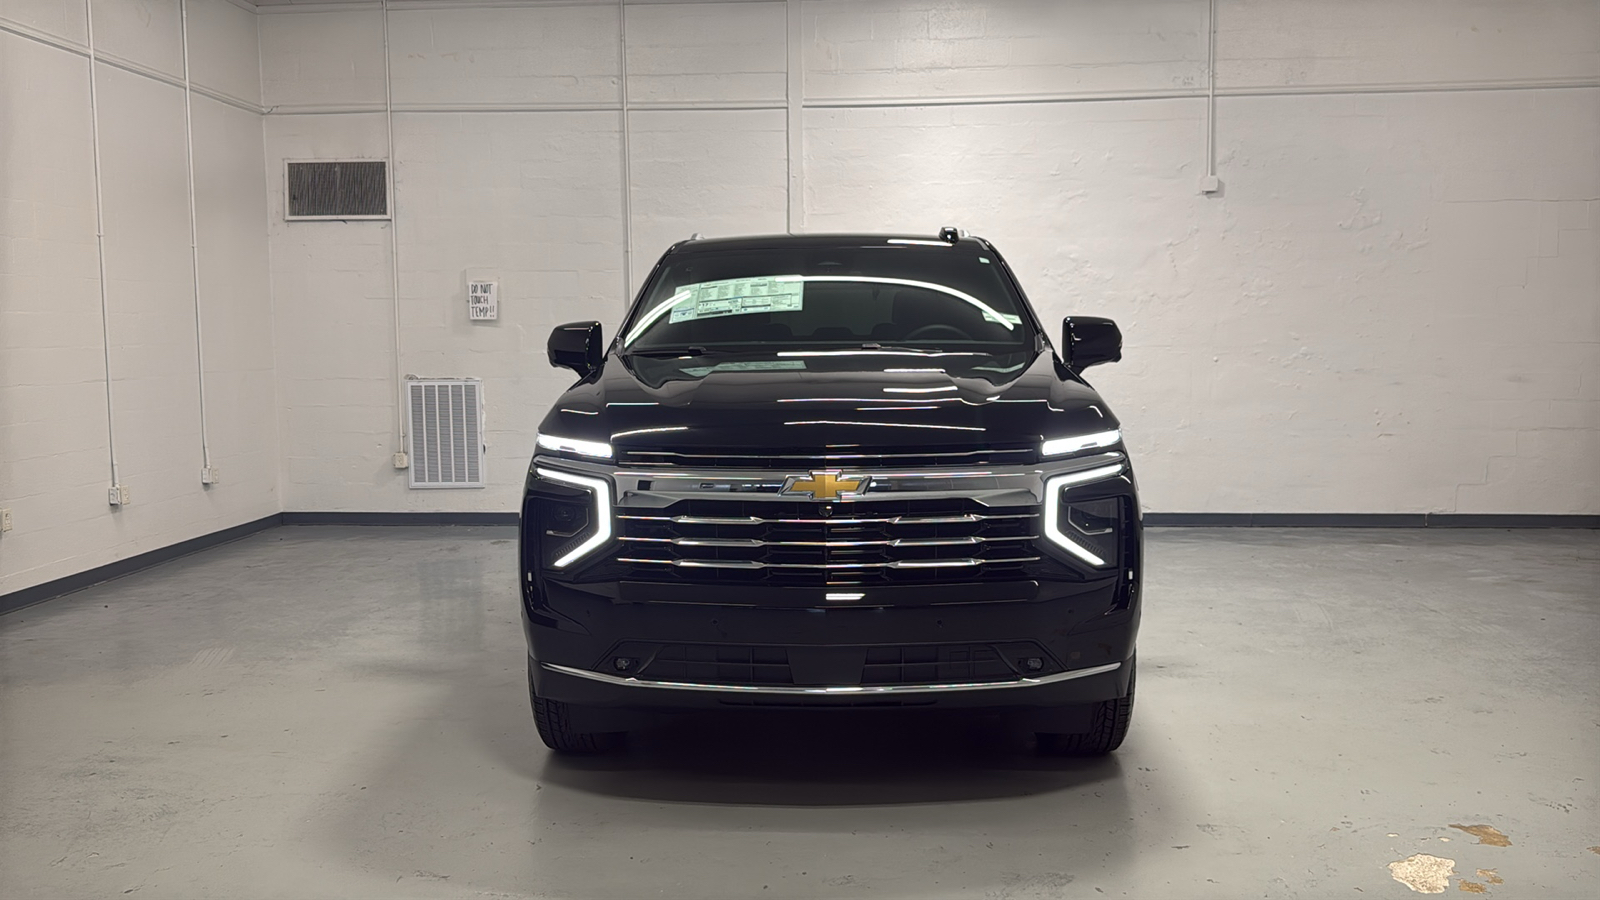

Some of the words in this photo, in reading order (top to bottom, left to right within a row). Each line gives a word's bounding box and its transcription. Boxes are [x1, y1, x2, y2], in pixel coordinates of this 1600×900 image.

[471, 284, 478, 294] DO
[480, 284, 493, 294] NOT
[470, 295, 488, 305] TOUCH
[471, 305, 494, 317] TEMP!!
